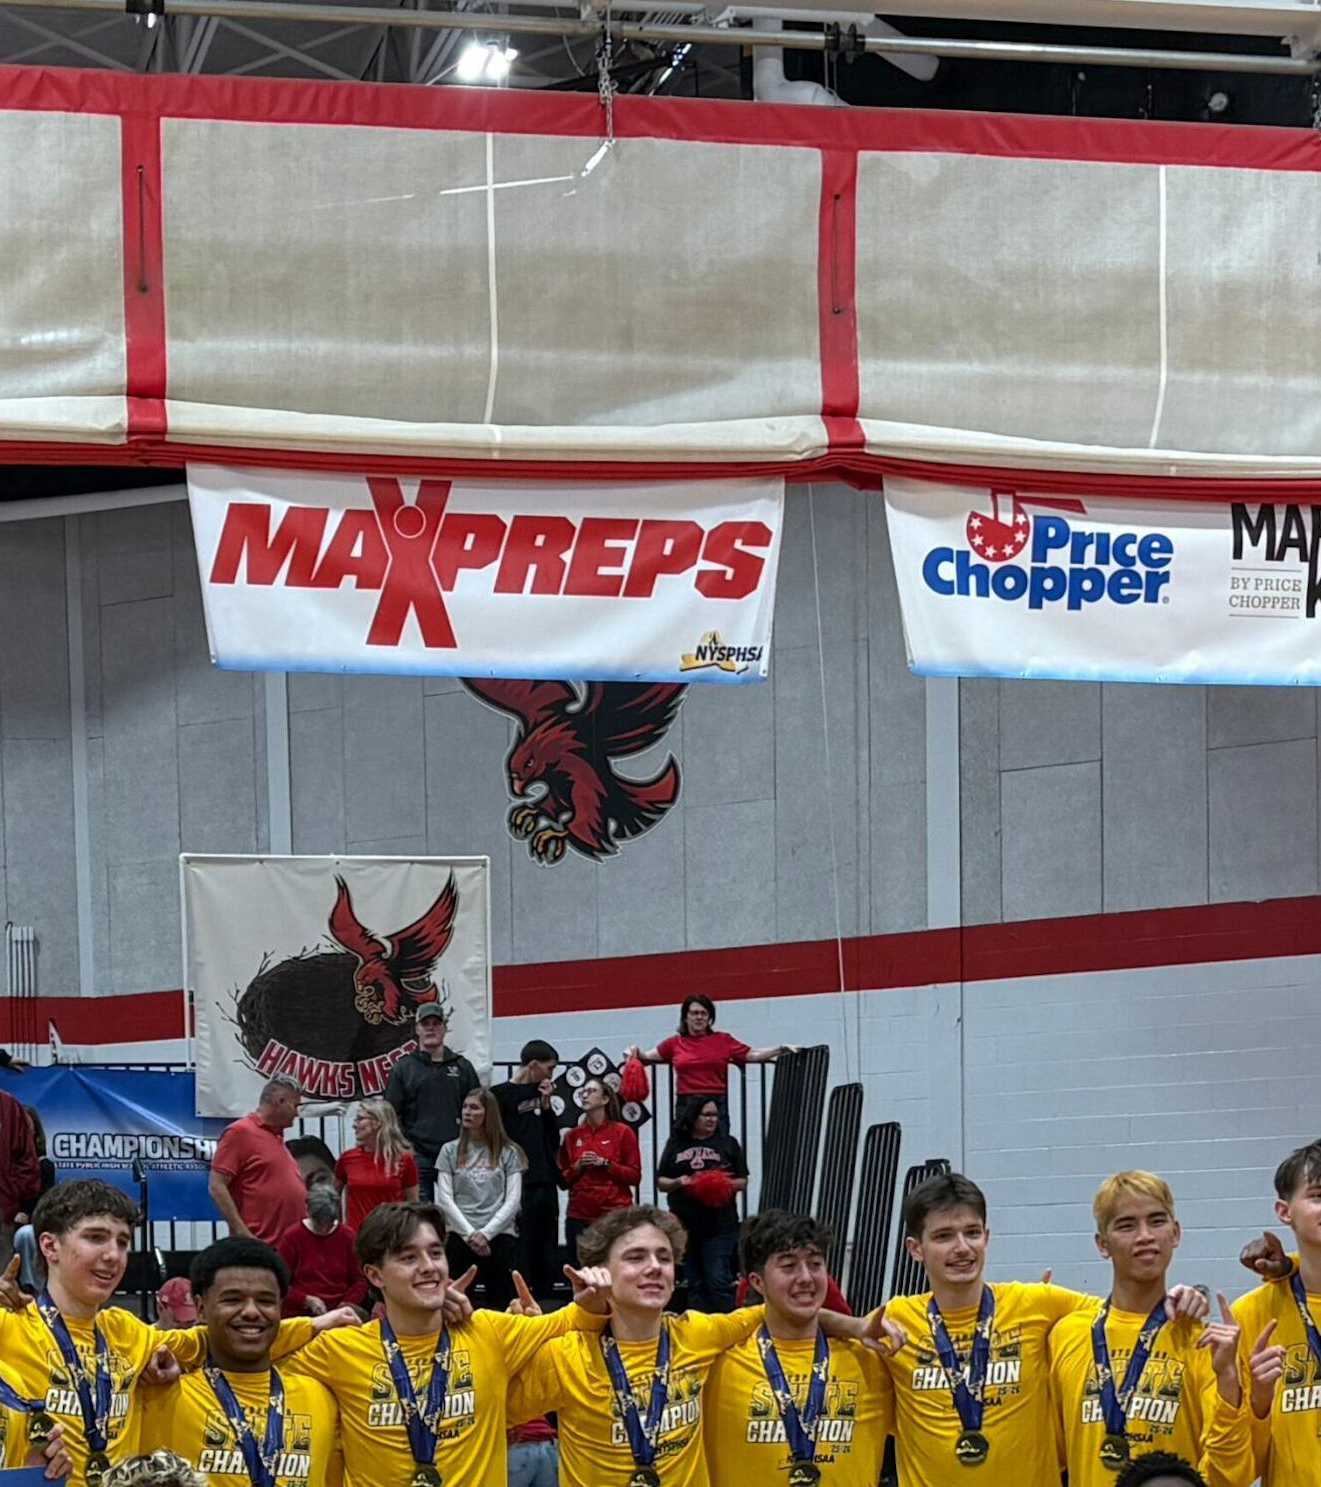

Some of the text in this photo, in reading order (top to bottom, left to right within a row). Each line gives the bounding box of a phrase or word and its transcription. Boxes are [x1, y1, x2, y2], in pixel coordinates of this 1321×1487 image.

[209, 477, 773, 649] MAXPREPS
[1031, 514, 1174, 568] Price
[922, 546, 1170, 610] Chopper
[1228, 594, 1301, 610] CHOPPER
[1230, 576, 1302, 592] BY PRICE
